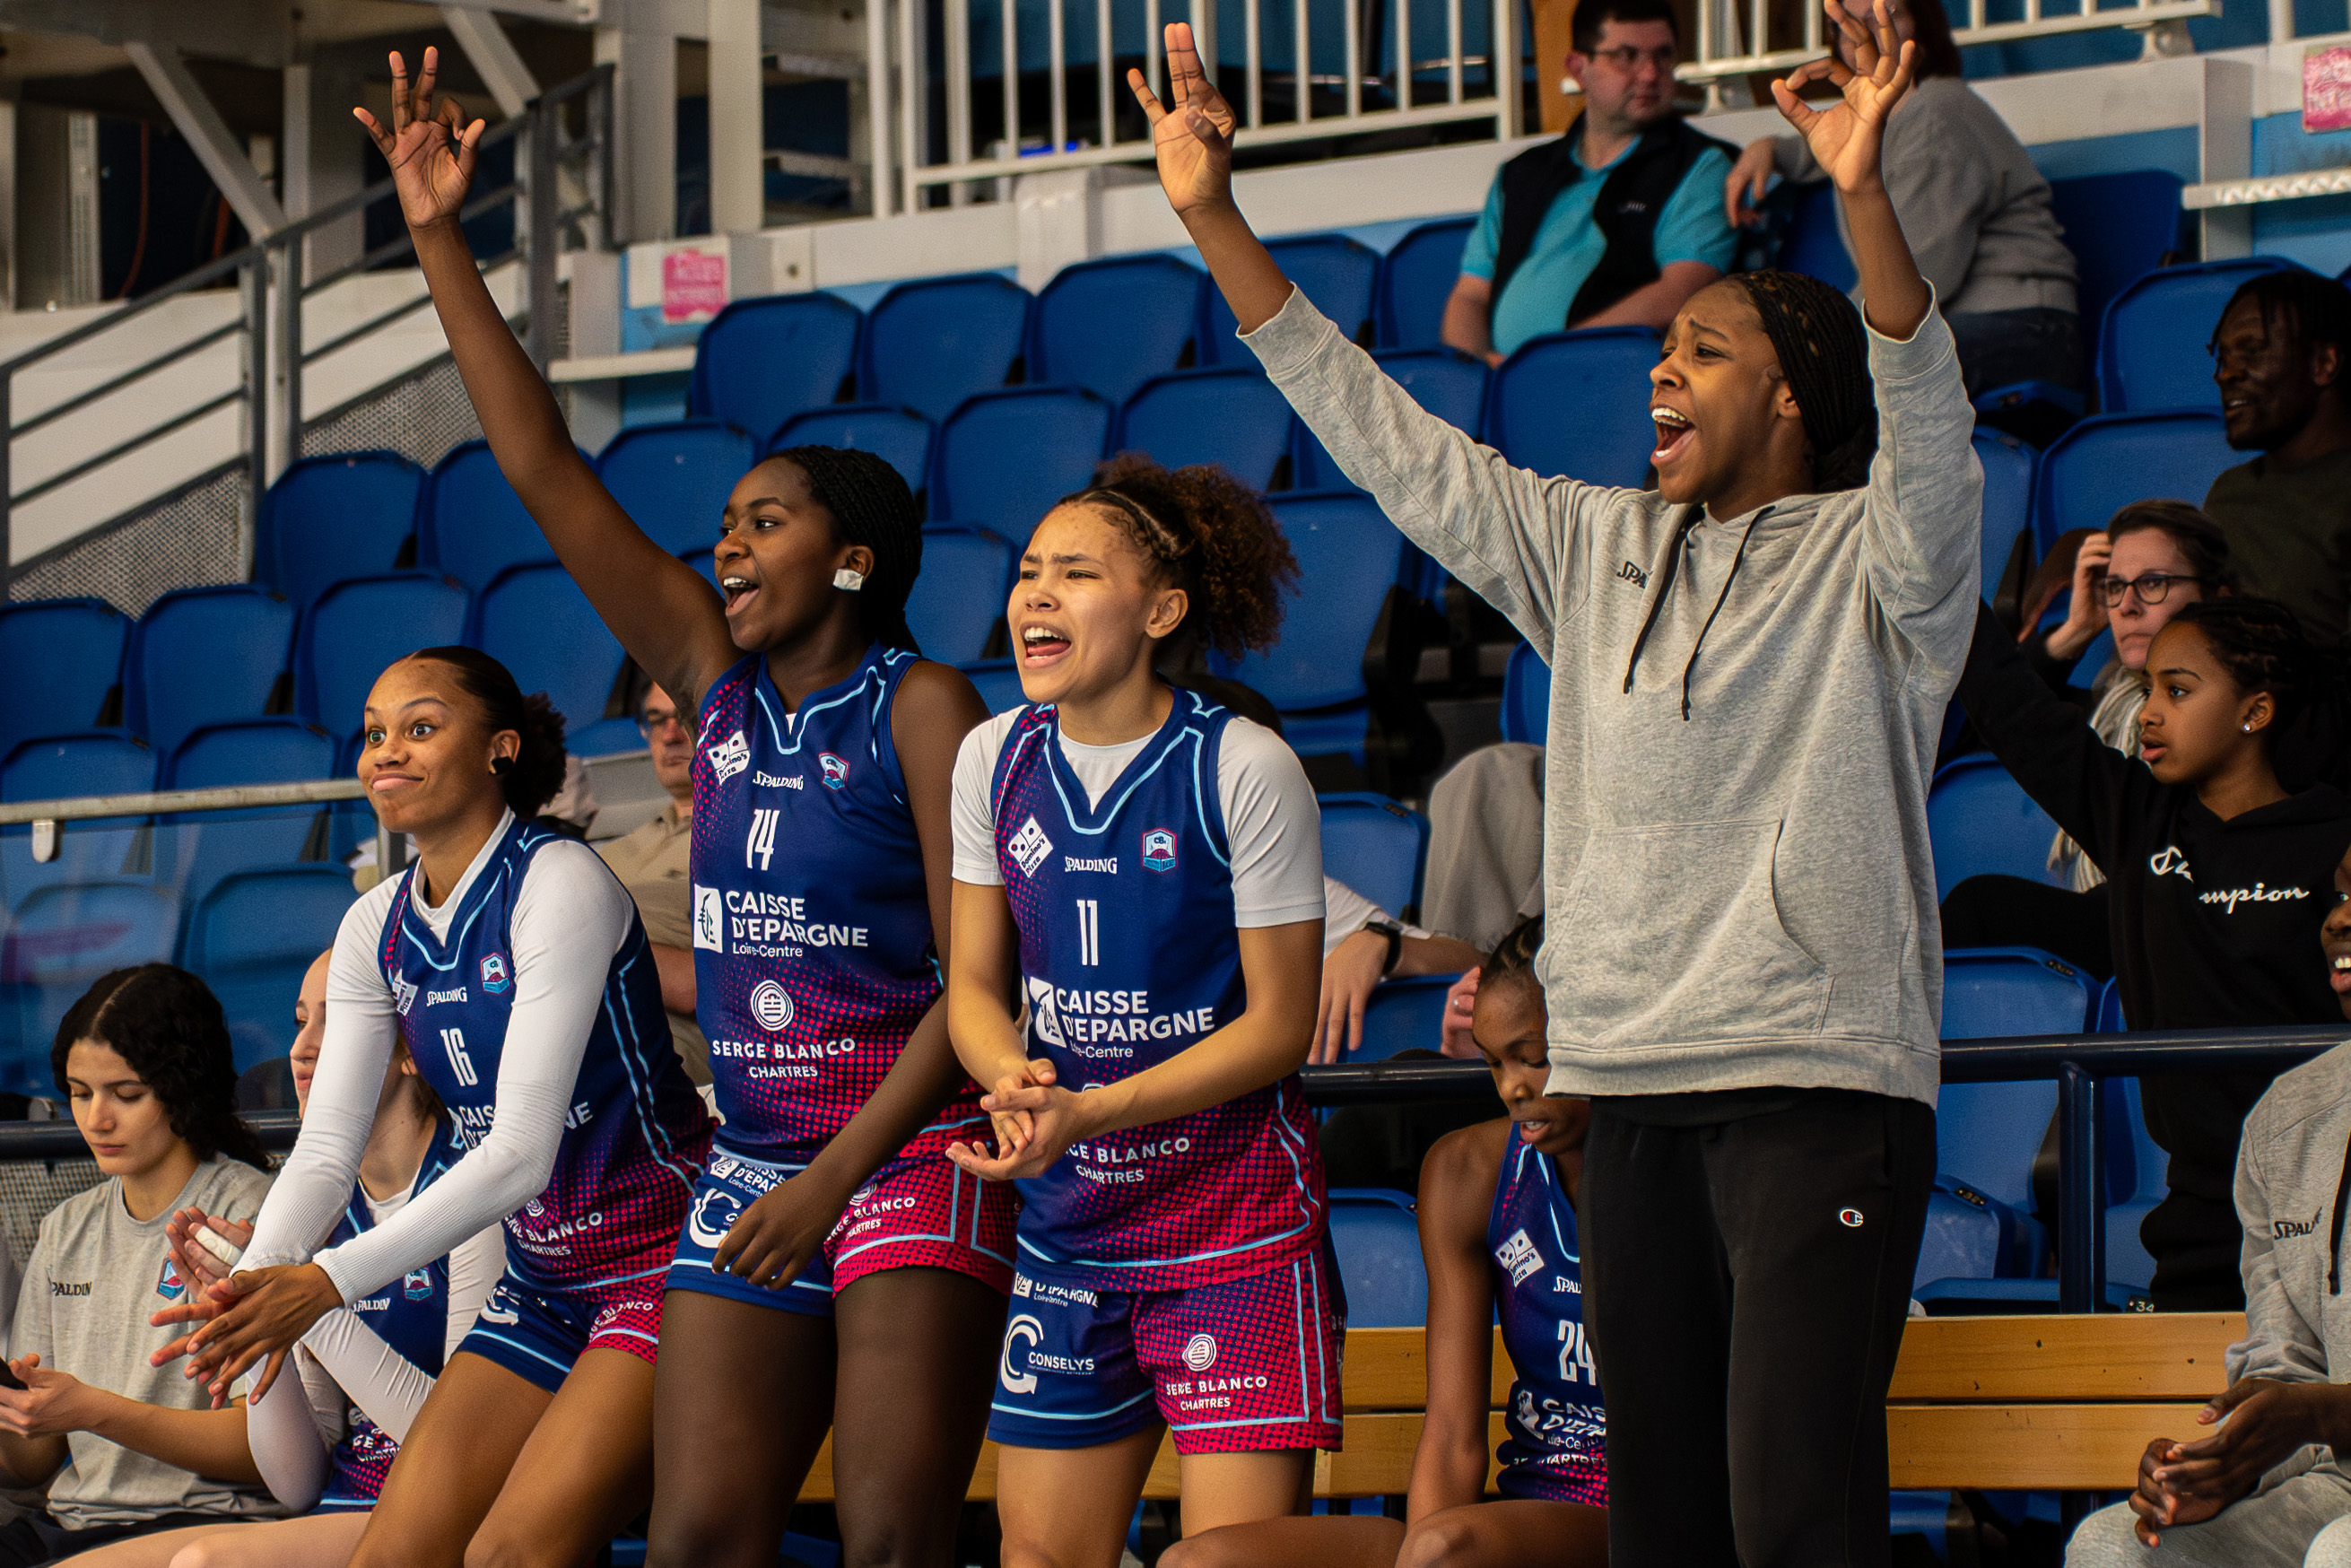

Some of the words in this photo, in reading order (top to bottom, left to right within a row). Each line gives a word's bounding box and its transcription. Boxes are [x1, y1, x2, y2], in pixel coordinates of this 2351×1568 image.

[753, 771, 804, 790] SPALDING
[746, 809, 780, 871] 14
[1065, 856, 1118, 875] SPALDING
[726, 890, 806, 920] CAISSE
[731, 916, 869, 947] D'EPARGNE
[1076, 899, 1099, 966] 11
[1056, 988, 1149, 1015] CAISSE
[1061, 1006, 1215, 1042] D'EPARGNE
[440, 1028, 478, 1087] 16
[712, 1040, 766, 1058] SERGE
[774, 1038, 856, 1058] BLANCO
[748, 1065, 818, 1078] CHARTRES
[1097, 1137, 1190, 1163] BLANCO
[1076, 1164, 1145, 1185] CHARTRES
[853, 1197, 916, 1219] BLANCO
[526, 1212, 603, 1242] BLANCO
[2136, 1301, 2155, 1313] 34
[1028, 1351, 1095, 1372] CONSELYS
[1557, 1320, 1596, 1386] 24
[1198, 1376, 1267, 1393] BLANCO
[1180, 1397, 1231, 1411] CHARTRES
